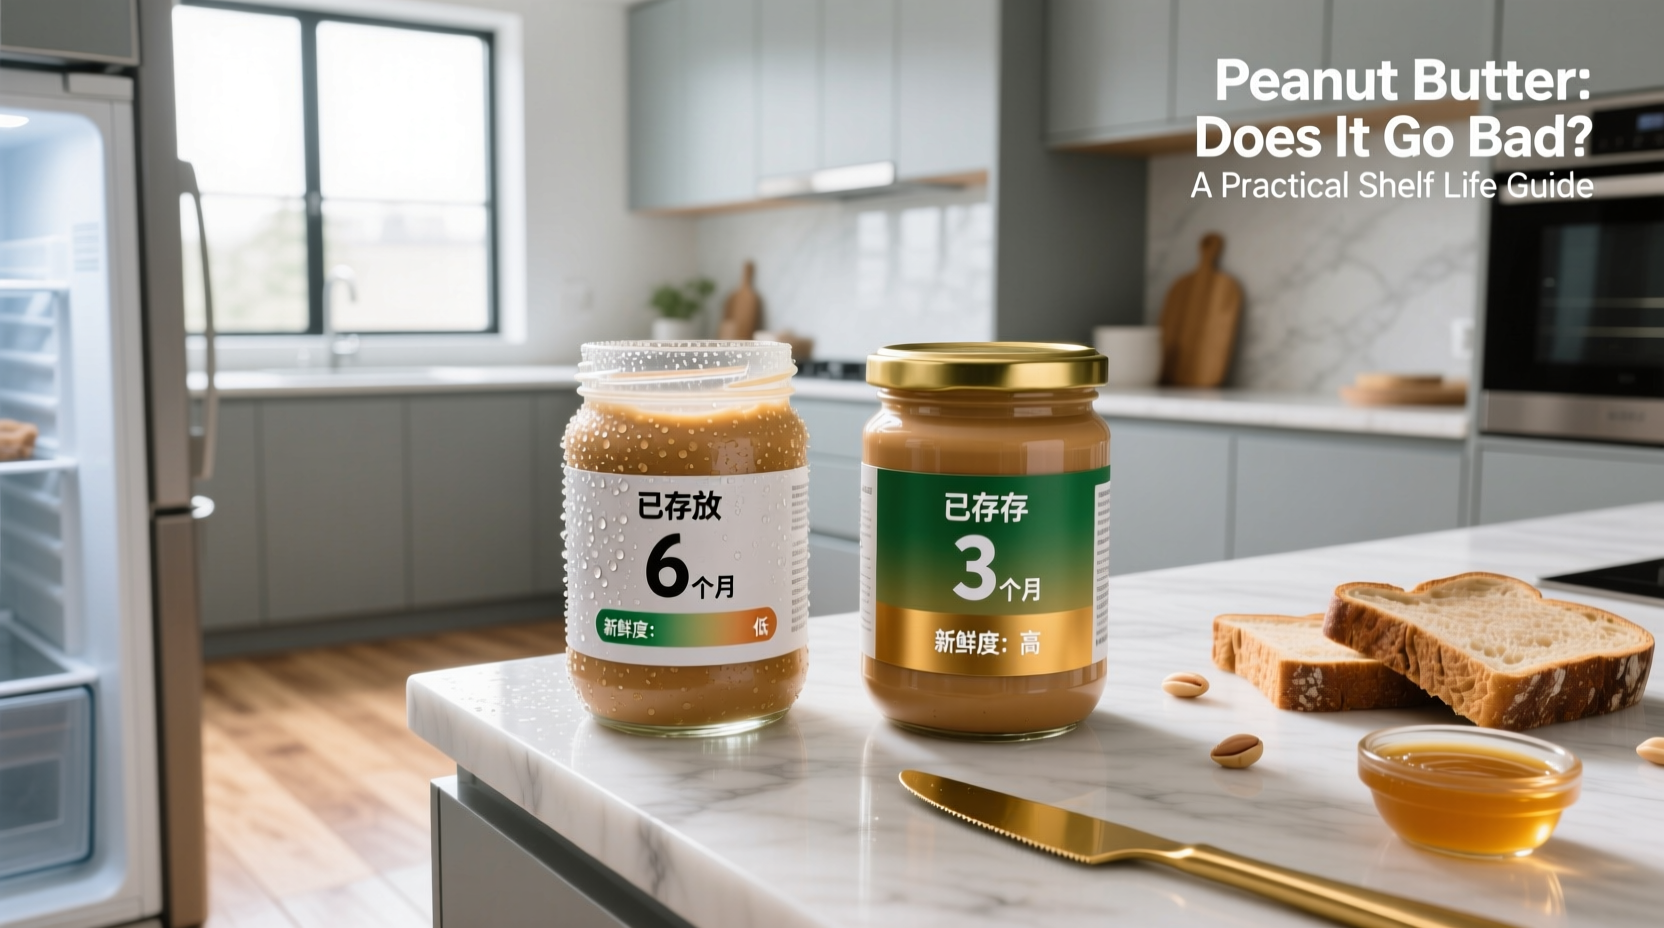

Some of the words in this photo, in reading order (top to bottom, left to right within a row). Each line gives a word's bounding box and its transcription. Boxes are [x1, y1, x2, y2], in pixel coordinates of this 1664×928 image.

[638, 490, 723, 521] 已存放
[945, 491, 1029, 523] 已存存
